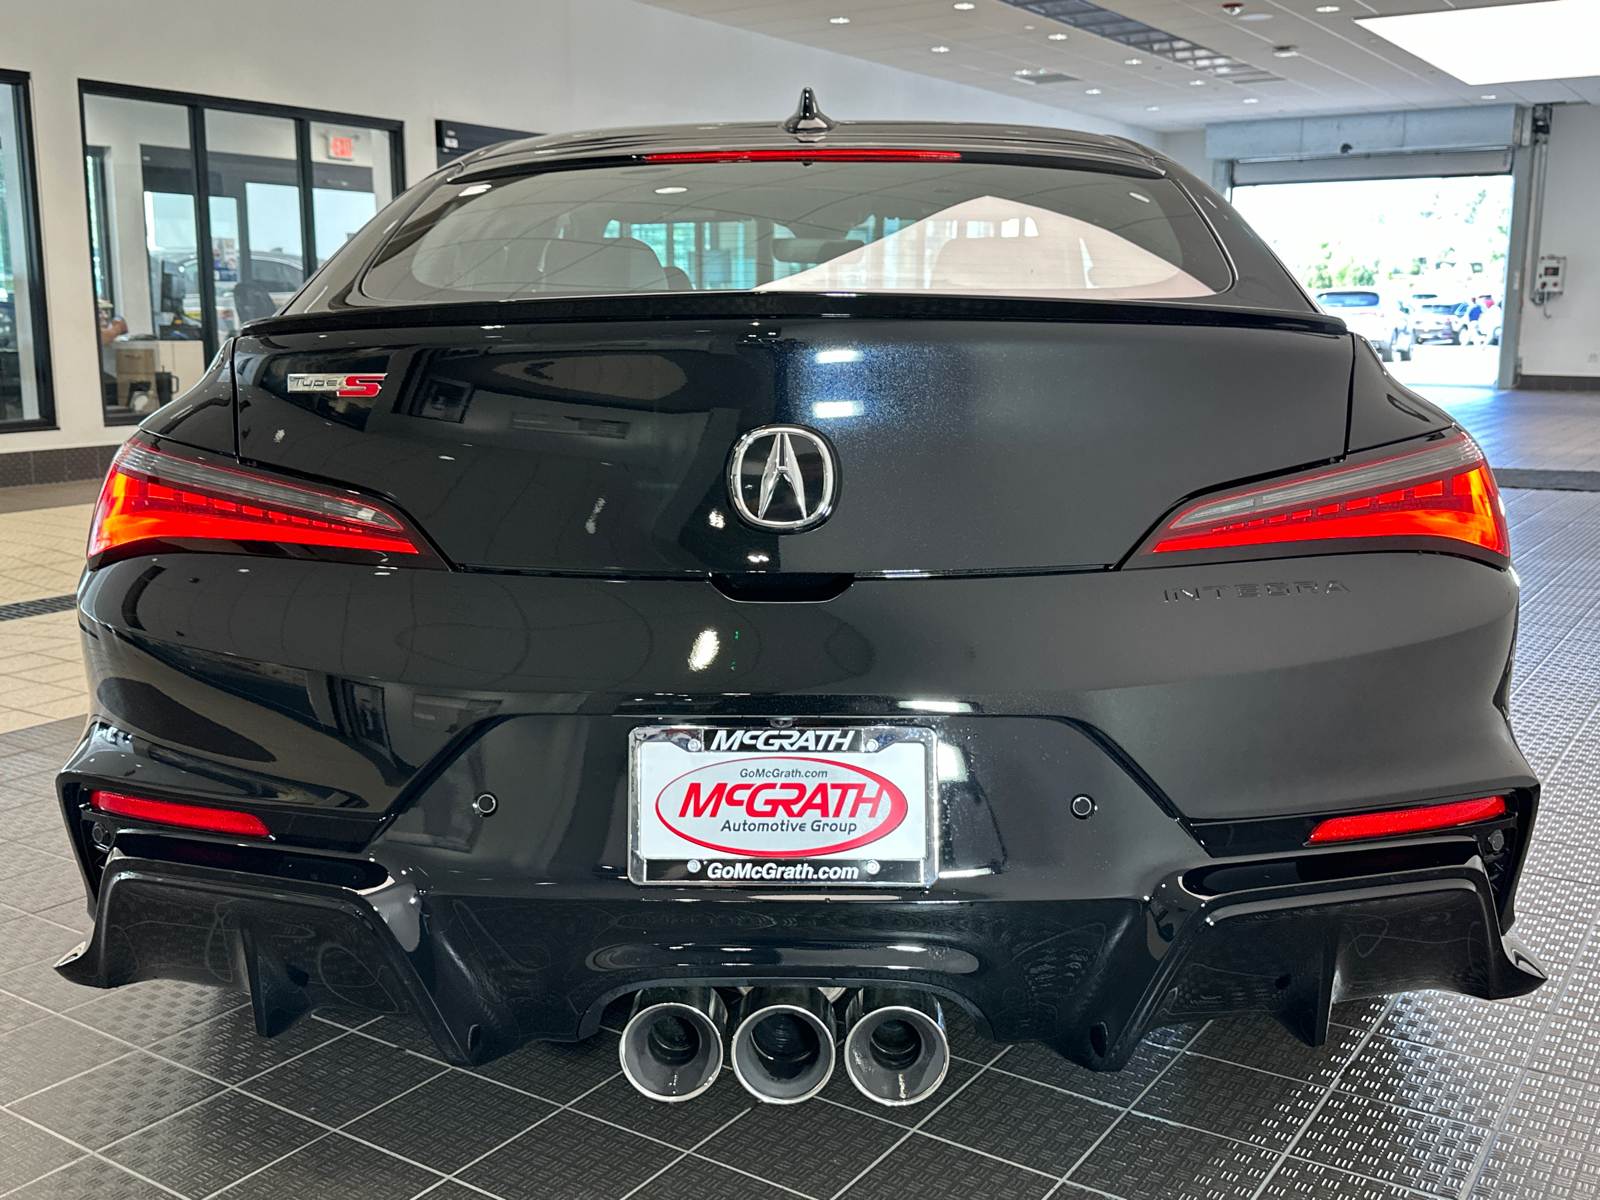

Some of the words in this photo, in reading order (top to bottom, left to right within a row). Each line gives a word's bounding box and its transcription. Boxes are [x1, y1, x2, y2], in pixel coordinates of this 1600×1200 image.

[291, 376, 338, 391] Type
[336, 372, 388, 397] S
[1163, 580, 1351, 603] INTEGRA
[739, 767, 828, 779] GoMcGrath.com
[720, 819, 807, 832] Automotive
[810, 819, 858, 836] Group
[706, 861, 860, 880] GoMcGrath.com
